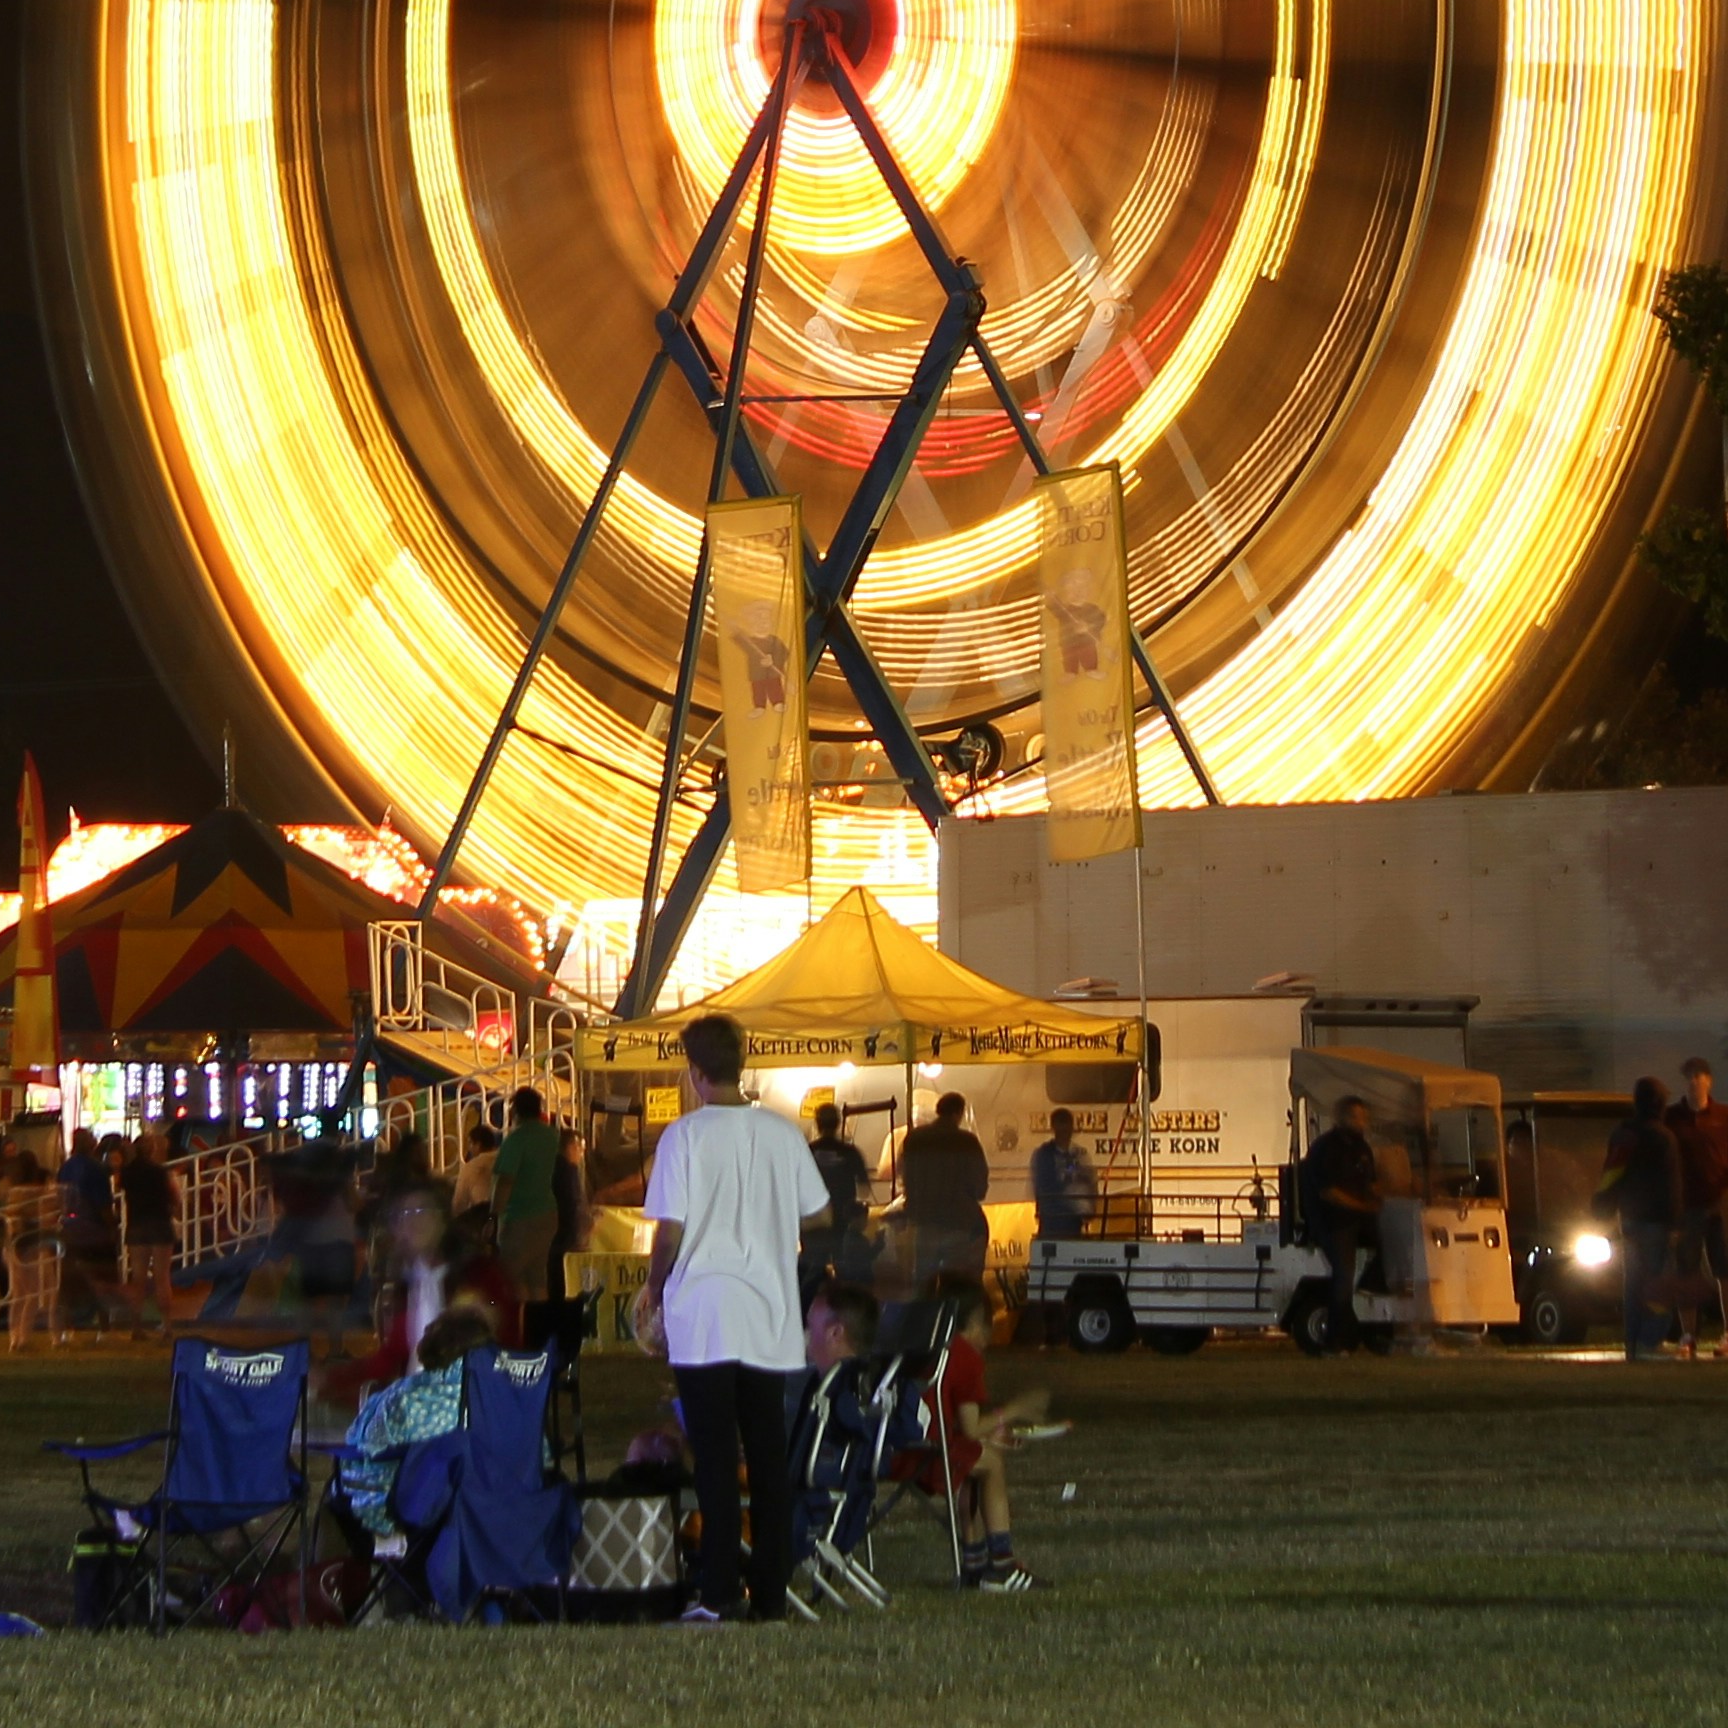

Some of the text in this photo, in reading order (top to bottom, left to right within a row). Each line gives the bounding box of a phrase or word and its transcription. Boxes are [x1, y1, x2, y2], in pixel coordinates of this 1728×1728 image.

[806, 1037, 853, 1055] CORN
[1095, 1138, 1161, 1154] KETTE
[1170, 1138, 1220, 1154] KORN
